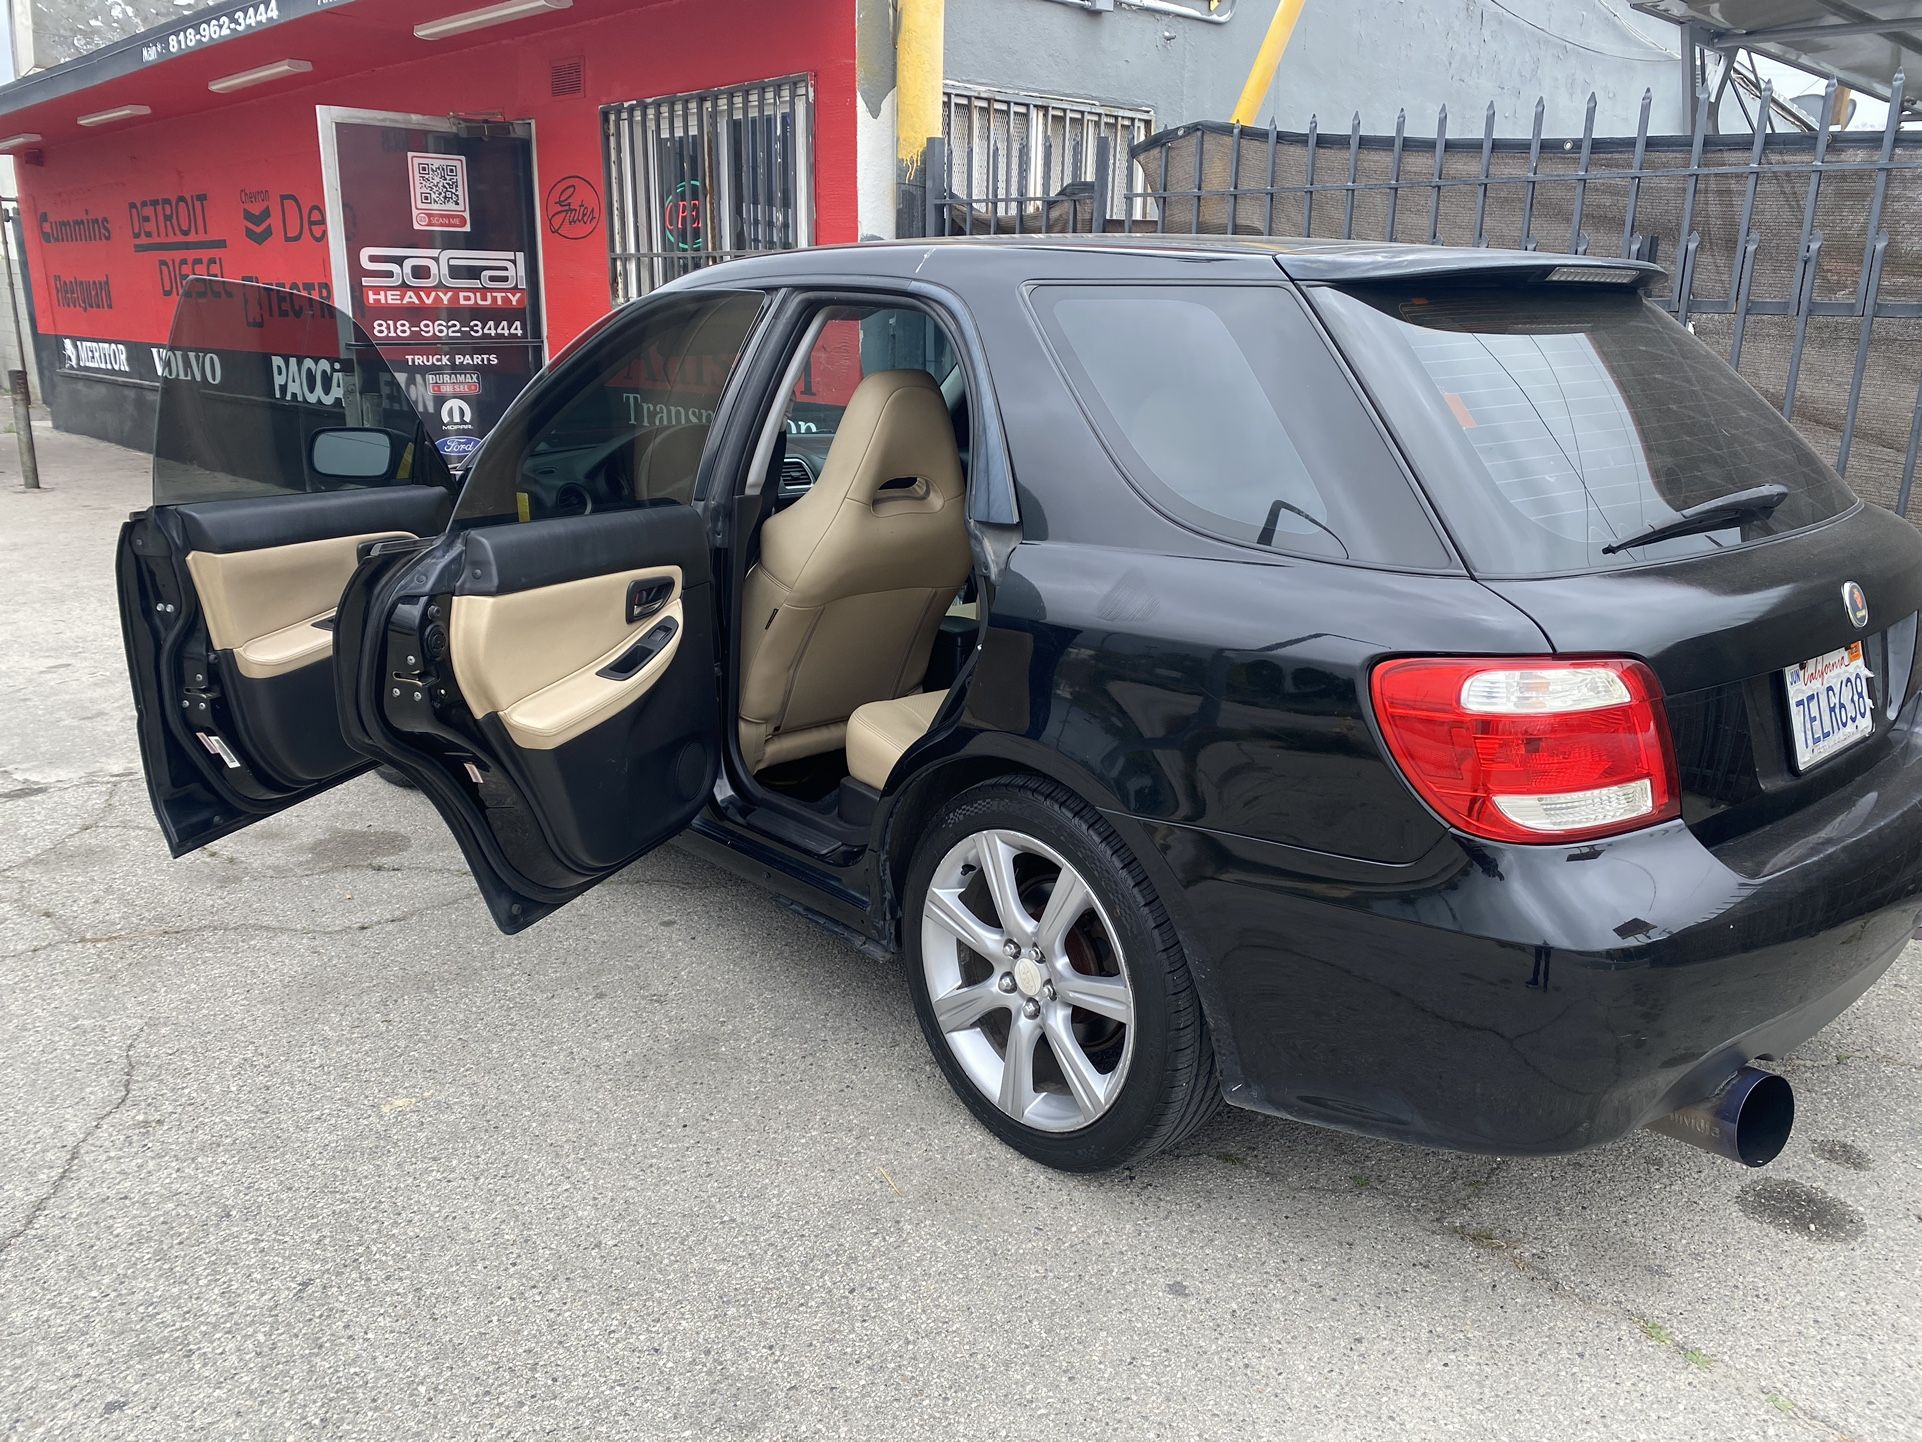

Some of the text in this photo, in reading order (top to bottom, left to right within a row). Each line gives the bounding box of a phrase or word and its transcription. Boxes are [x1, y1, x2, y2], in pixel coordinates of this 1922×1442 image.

[168, 0, 278, 53] 818-962-3444
[240, 188, 270, 204] Chevron
[550, 184, 596, 234] Gates
[38, 209, 112, 244] Cummins
[128, 194, 208, 239] DETROIT
[430, 216, 461, 225] SCAN ME
[53, 273, 113, 312] Fleetguard
[158, 256, 235, 298] DIESEL
[367, 290, 522, 306] HEAVY DUTY
[373, 319, 523, 338] 818-962-3444
[76, 340, 131, 372] MERITOR
[150, 347, 222, 386] VOLVO
[405, 354, 498, 366] TRUCK PARTS
[428, 373, 479, 384] DURAMAX
[440, 384, 470, 392] DIESEL
[444, 439, 474, 452] Ford
[1802, 655, 1851, 687] California
[1795, 672, 1867, 750] 7ELR638
